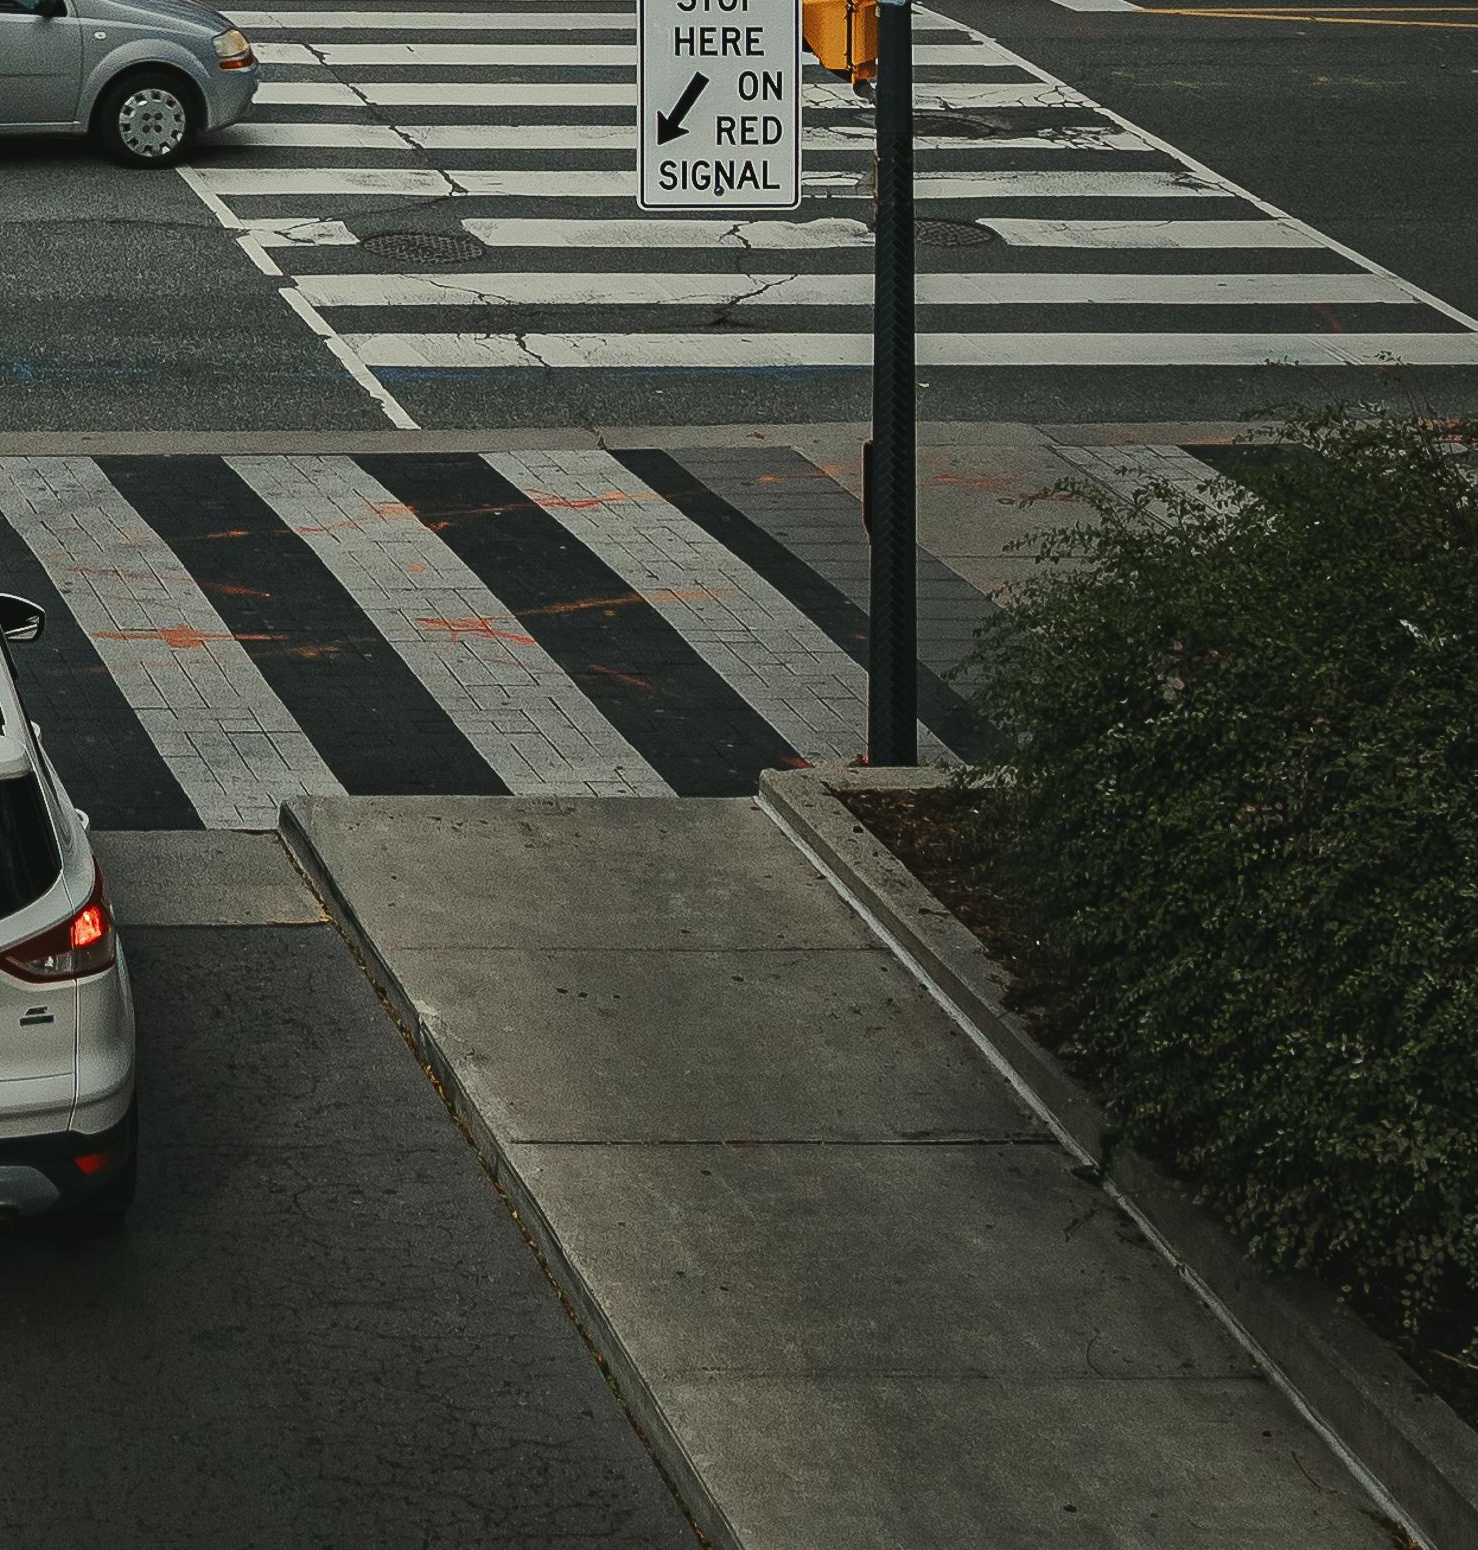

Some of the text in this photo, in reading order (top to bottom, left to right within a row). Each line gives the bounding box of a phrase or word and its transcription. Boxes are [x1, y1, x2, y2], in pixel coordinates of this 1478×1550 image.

[674, 26, 764, 56] HERE
[738, 71, 782, 101] ON
[716, 116, 782, 145] RED
[658, 160, 780, 190] SIGNAL
